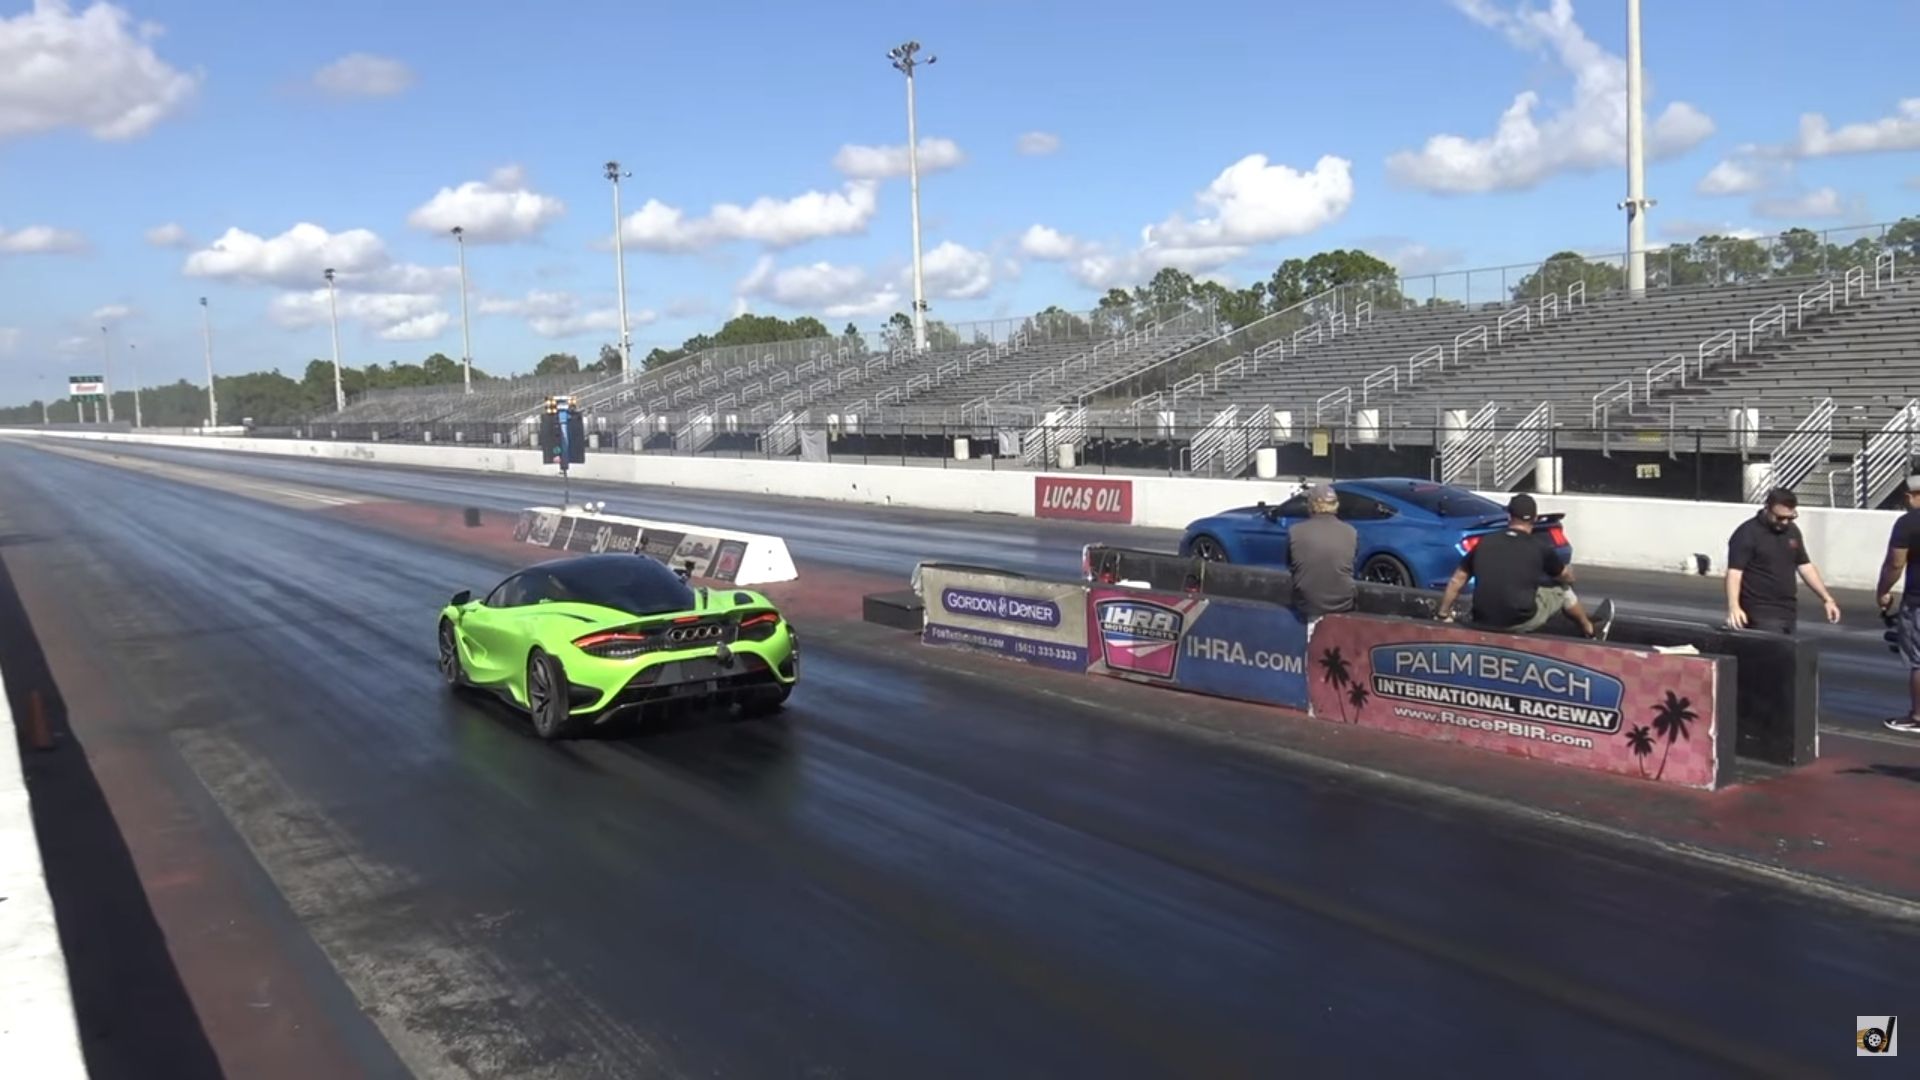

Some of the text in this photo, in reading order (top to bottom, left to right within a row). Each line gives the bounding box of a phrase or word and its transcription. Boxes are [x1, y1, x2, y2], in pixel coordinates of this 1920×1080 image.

[1043, 485, 1122, 512] LUCAS OIL
[590, 526, 612, 553] 50
[947, 592, 997, 614] GORDON
[1105, 606, 1175, 631] IHRA
[1187, 636, 1303, 674] IHRA.COM
[1396, 651, 1591, 701] PALM BEACH
[1378, 678, 1614, 727] INTERNATIONAL RACEWAY
[1394, 706, 1593, 749] www.RacePBIR.com
